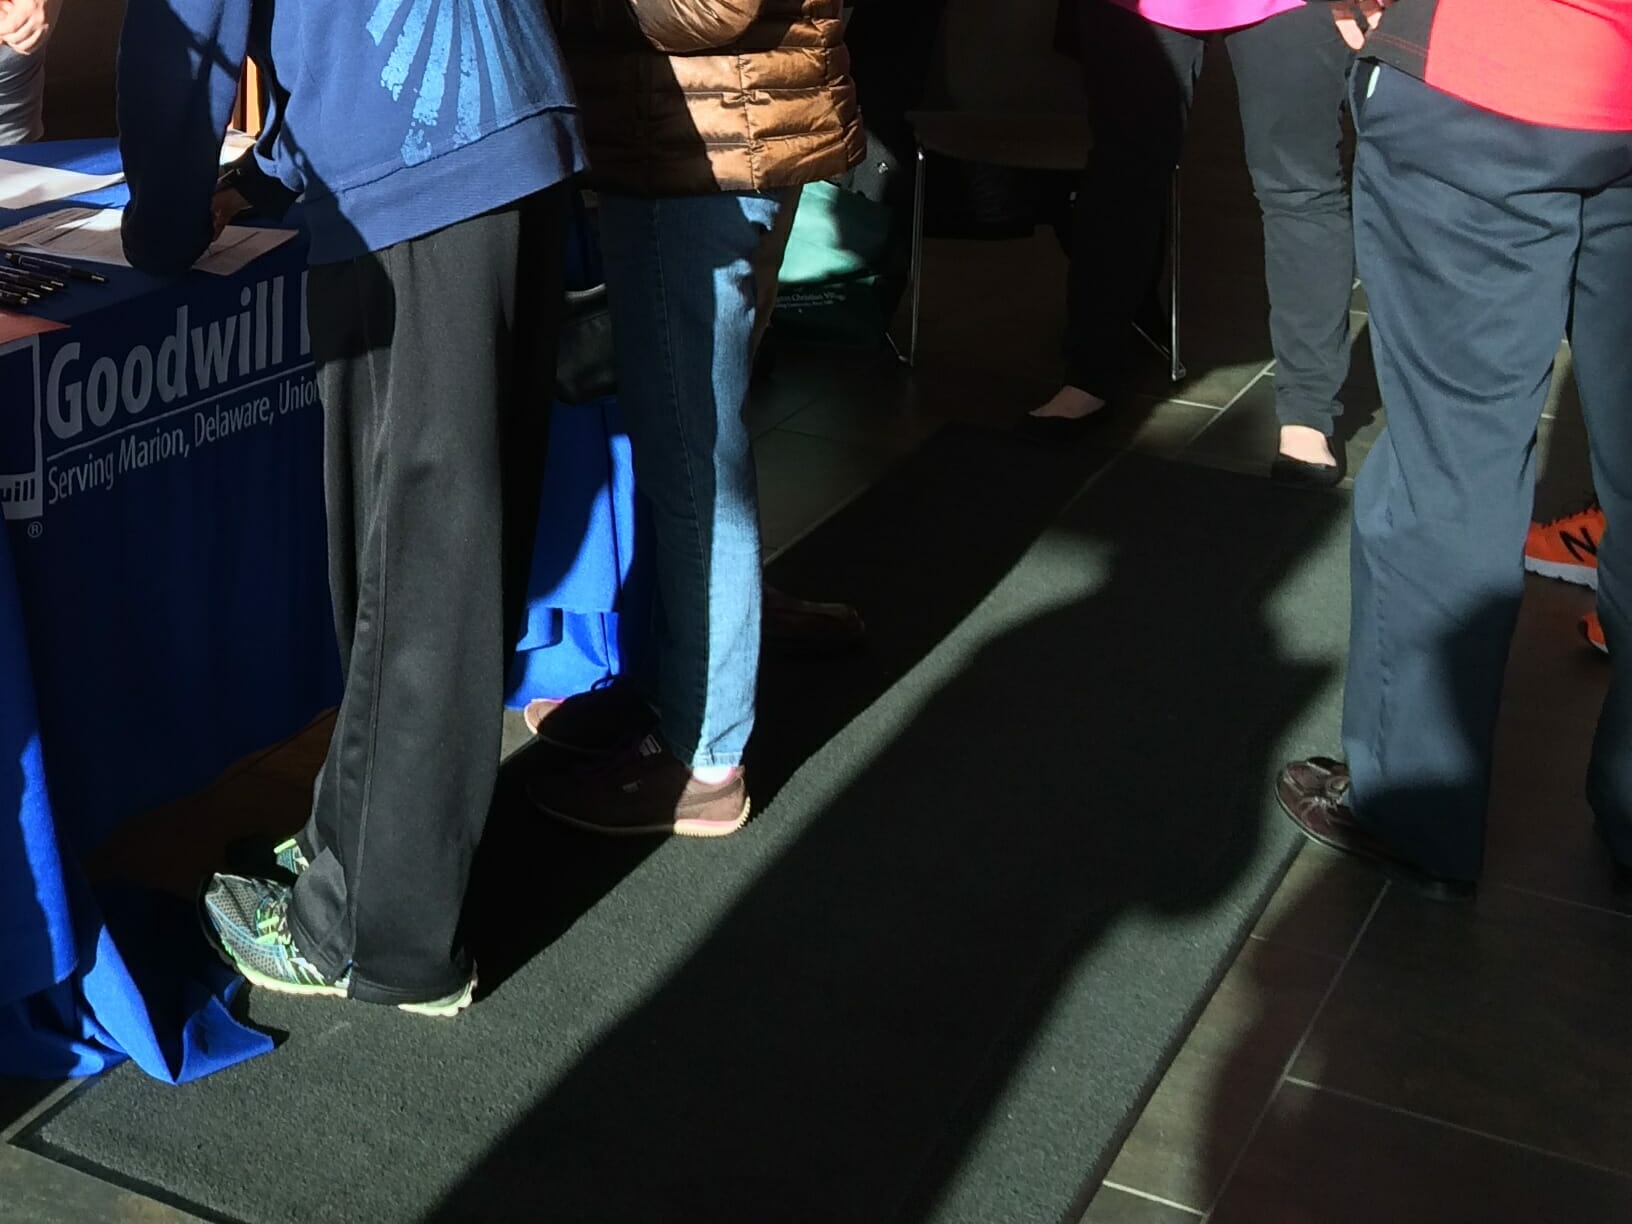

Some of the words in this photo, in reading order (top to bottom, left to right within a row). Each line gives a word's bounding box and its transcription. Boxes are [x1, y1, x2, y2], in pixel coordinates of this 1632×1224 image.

[45, 273, 285, 441] Goodwill
[48, 452, 114, 505] Serving
[118, 423, 191, 478] Marion,
[194, 397, 275, 443] Delaware,
[1559, 526, 1598, 562] N
